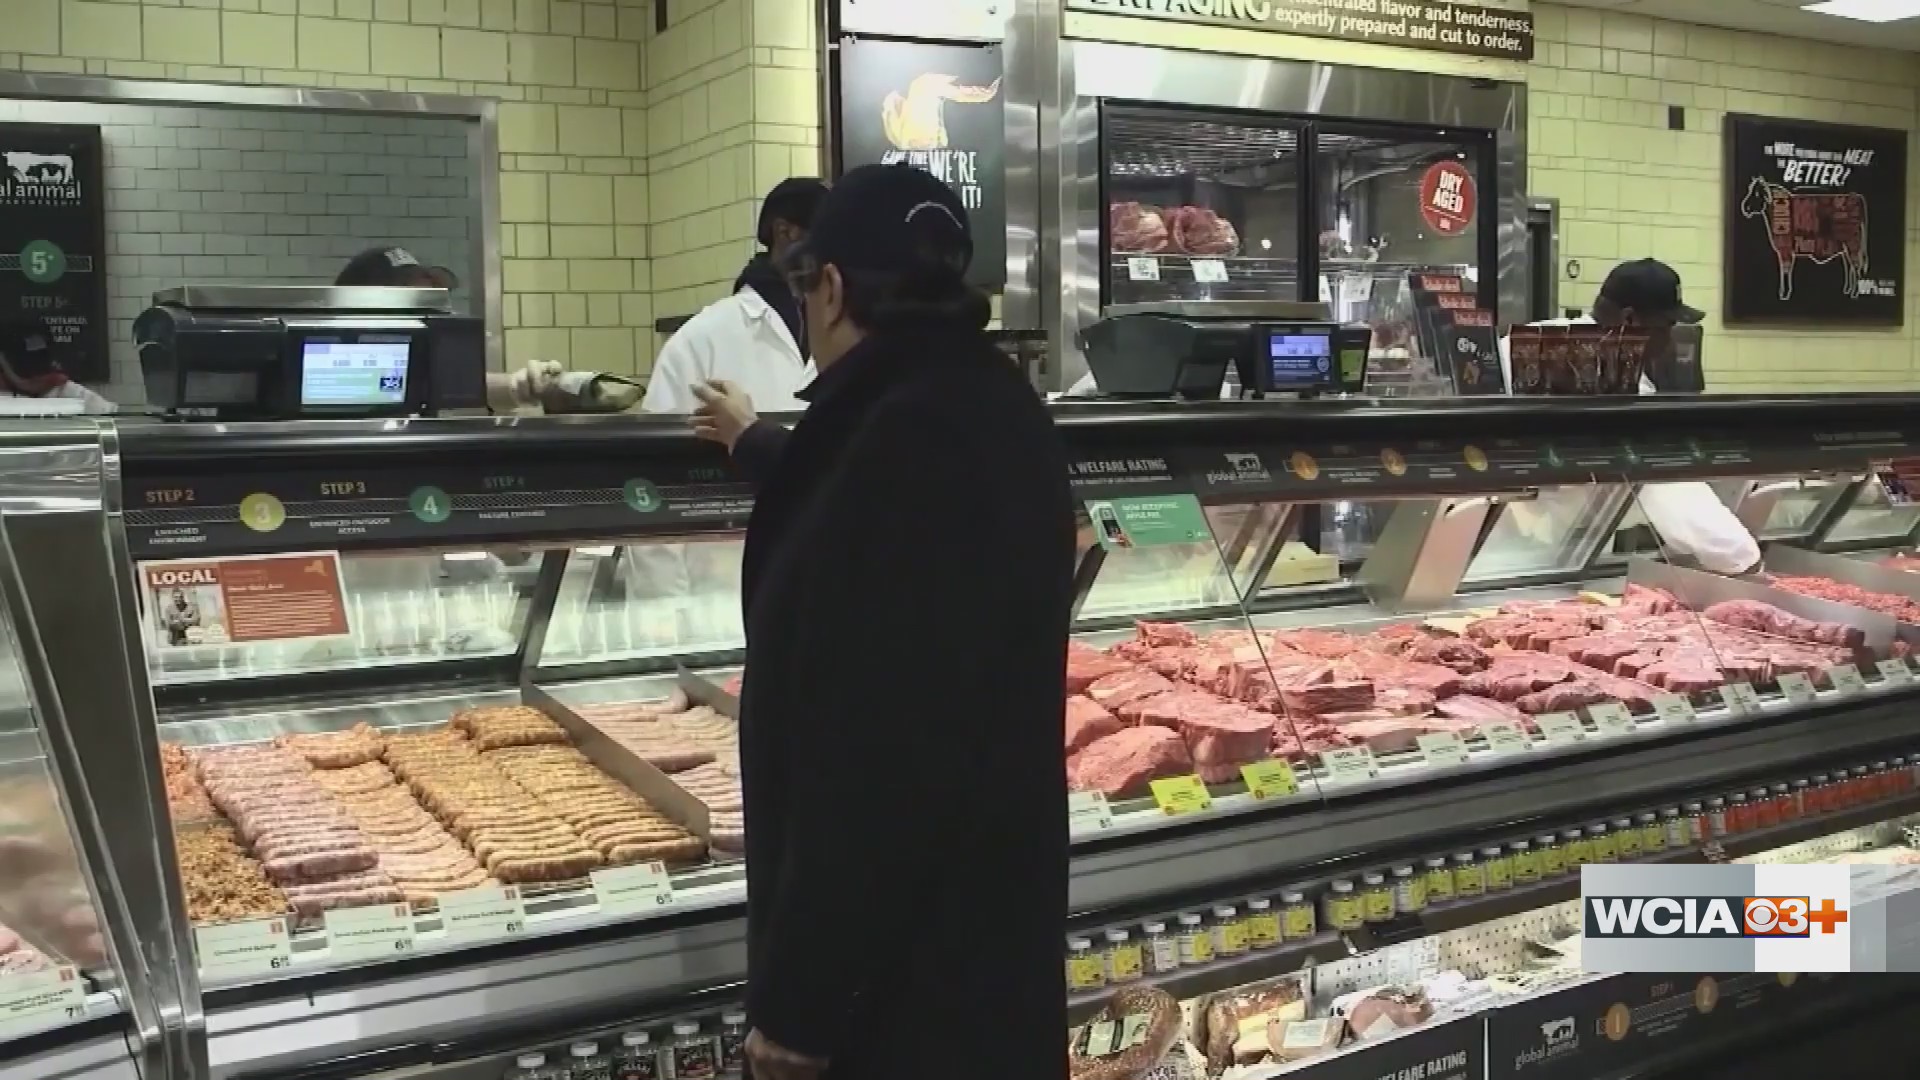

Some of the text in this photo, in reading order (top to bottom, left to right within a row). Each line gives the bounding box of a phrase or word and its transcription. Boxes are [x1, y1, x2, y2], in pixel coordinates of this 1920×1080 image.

[1275, 7, 1523, 52] expertly prepared and cut to order.
[1425, 6, 1451, 22] and
[1455, 10, 1534, 36] tenderness,
[928, 149, 977, 183] WE'RE
[1783, 160, 1851, 186] BETTER!
[15, 180, 82, 199] animal
[1439, 169, 1464, 193] DRY
[1432, 188, 1464, 213] AGED
[1077, 459, 1126, 474] WELFARE
[1127, 457, 1168, 472] RATING
[146, 489, 182, 503] STEP
[320, 481, 354, 495] STEP
[635, 487, 651, 506] 5
[254, 502, 271, 524] 3
[422, 495, 438, 515] 4
[151, 568, 217, 585] LOCAL
[1427, 1050, 1468, 1076] RATING
